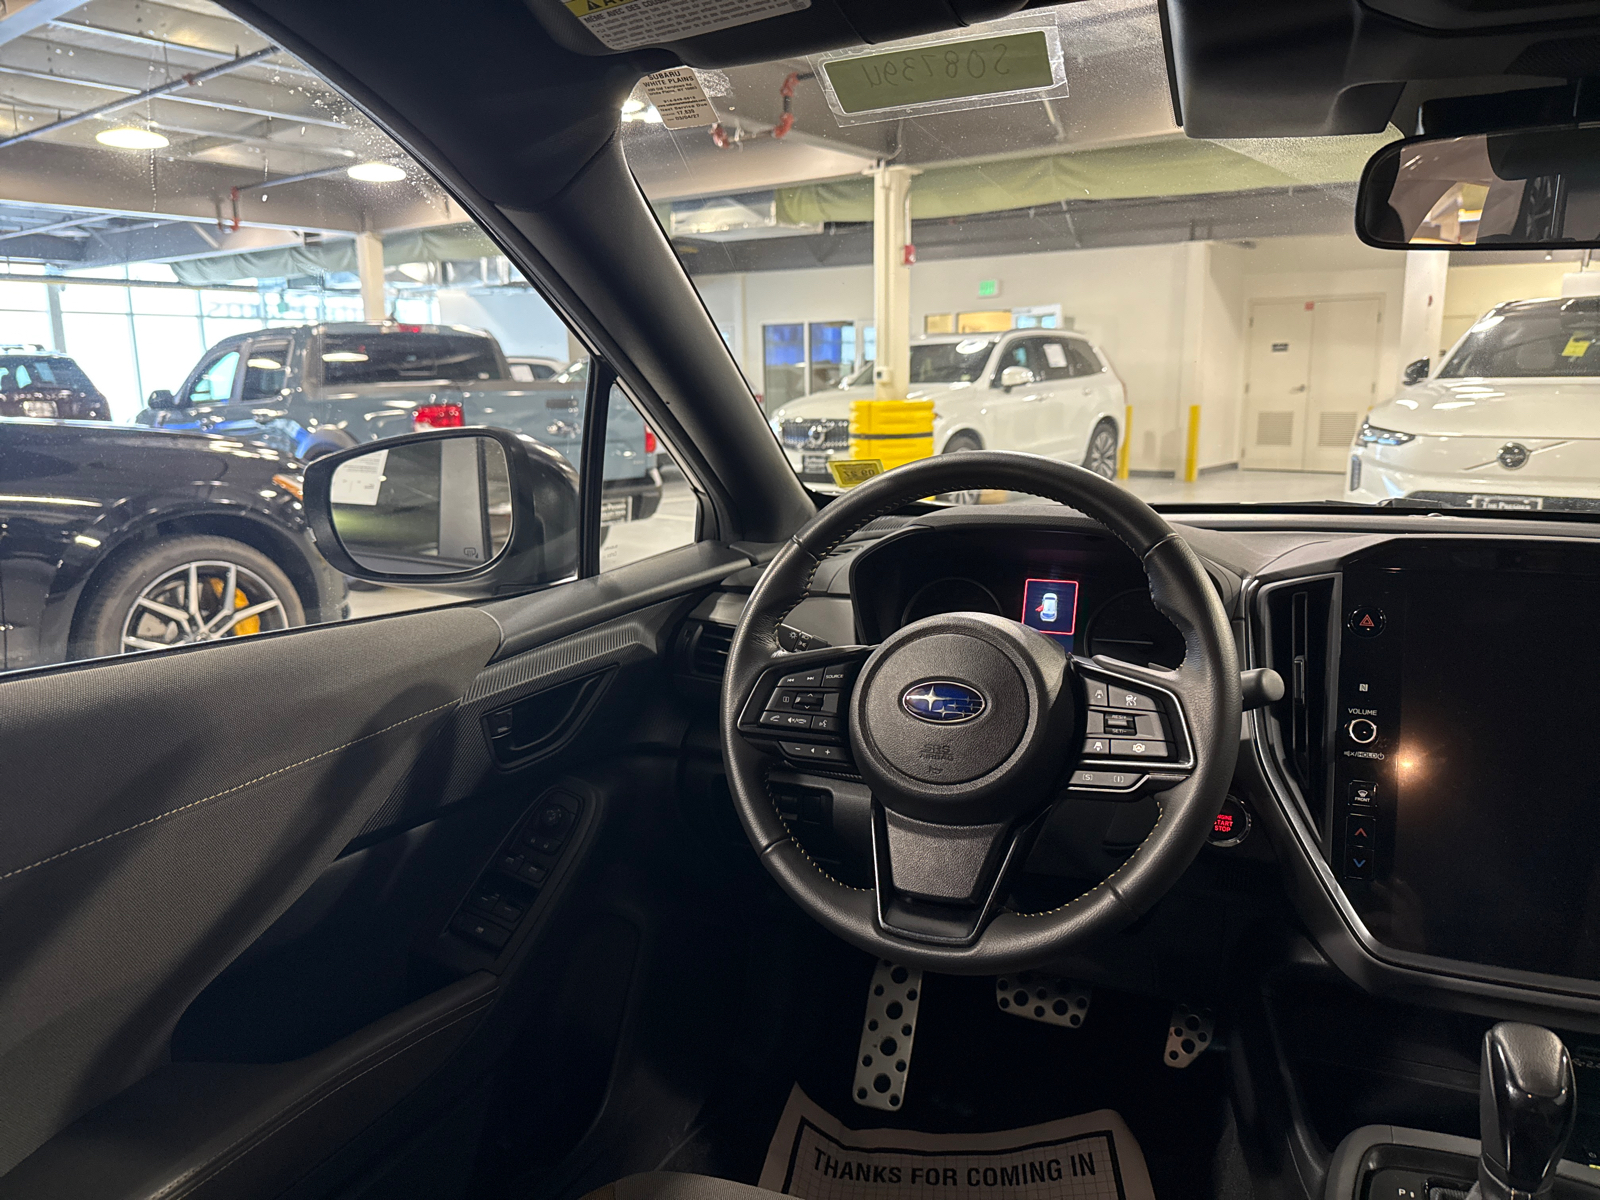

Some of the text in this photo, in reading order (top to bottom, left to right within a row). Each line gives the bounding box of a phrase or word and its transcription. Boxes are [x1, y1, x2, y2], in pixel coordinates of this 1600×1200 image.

[606, 8, 625, 18] AVEC
[625, 4, 641, 13] DES
[648, 71, 680, 80] SUBARU
[643, 76, 694, 88] WHITE PLAINS
[1348, 708, 1378, 716] VOLUME
[814, 1147, 1096, 1187] THANKS FOR COMING IN
[1398, 1188, 1406, 1196] P
